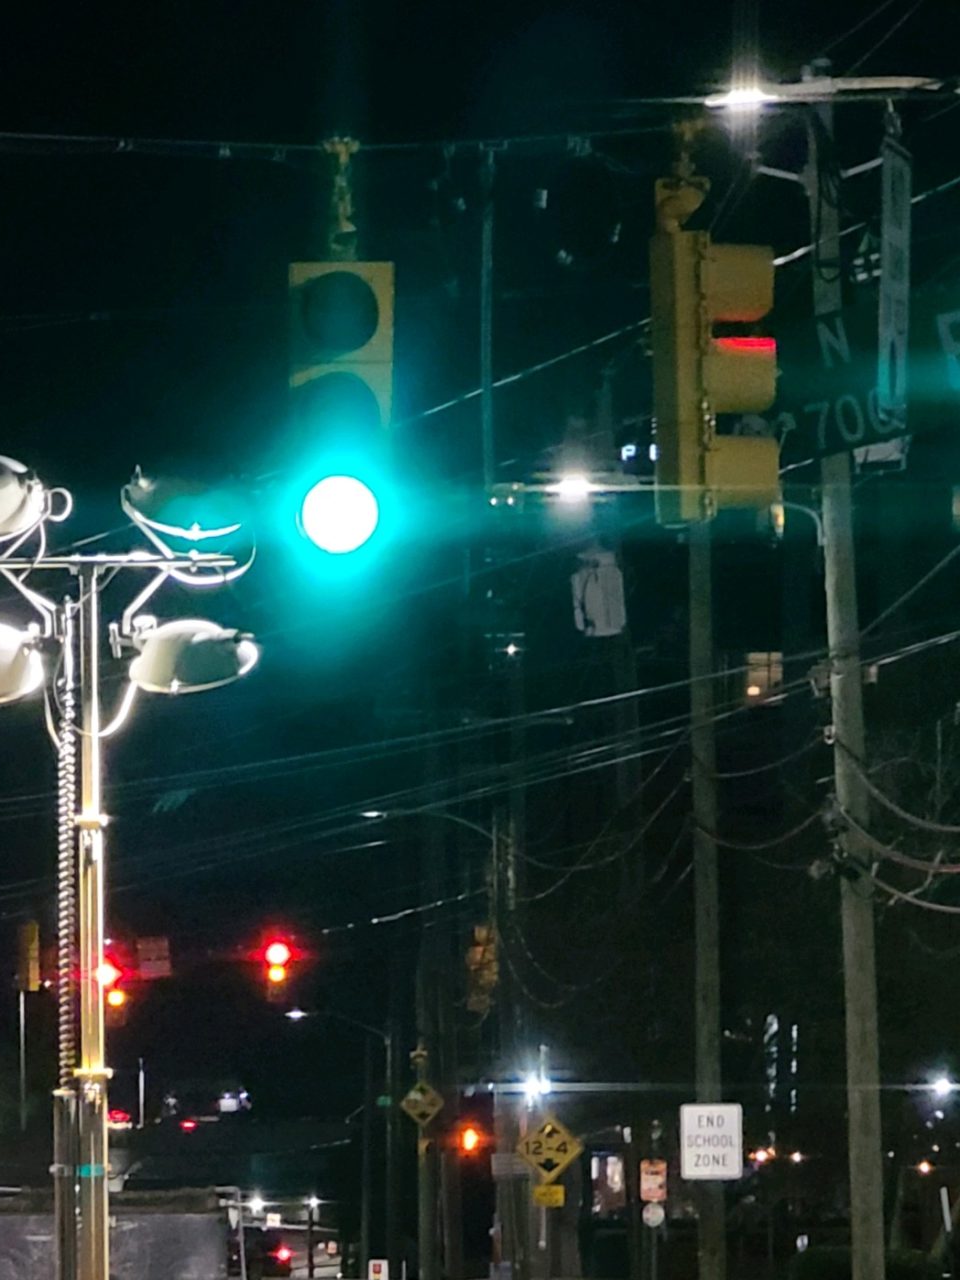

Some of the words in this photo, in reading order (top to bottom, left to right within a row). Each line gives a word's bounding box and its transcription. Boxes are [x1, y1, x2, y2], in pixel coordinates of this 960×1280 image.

[697, 1115, 725, 1129] END
[687, 1134, 735, 1148] SCHOOL
[694, 1153, 728, 1168] ZONE
